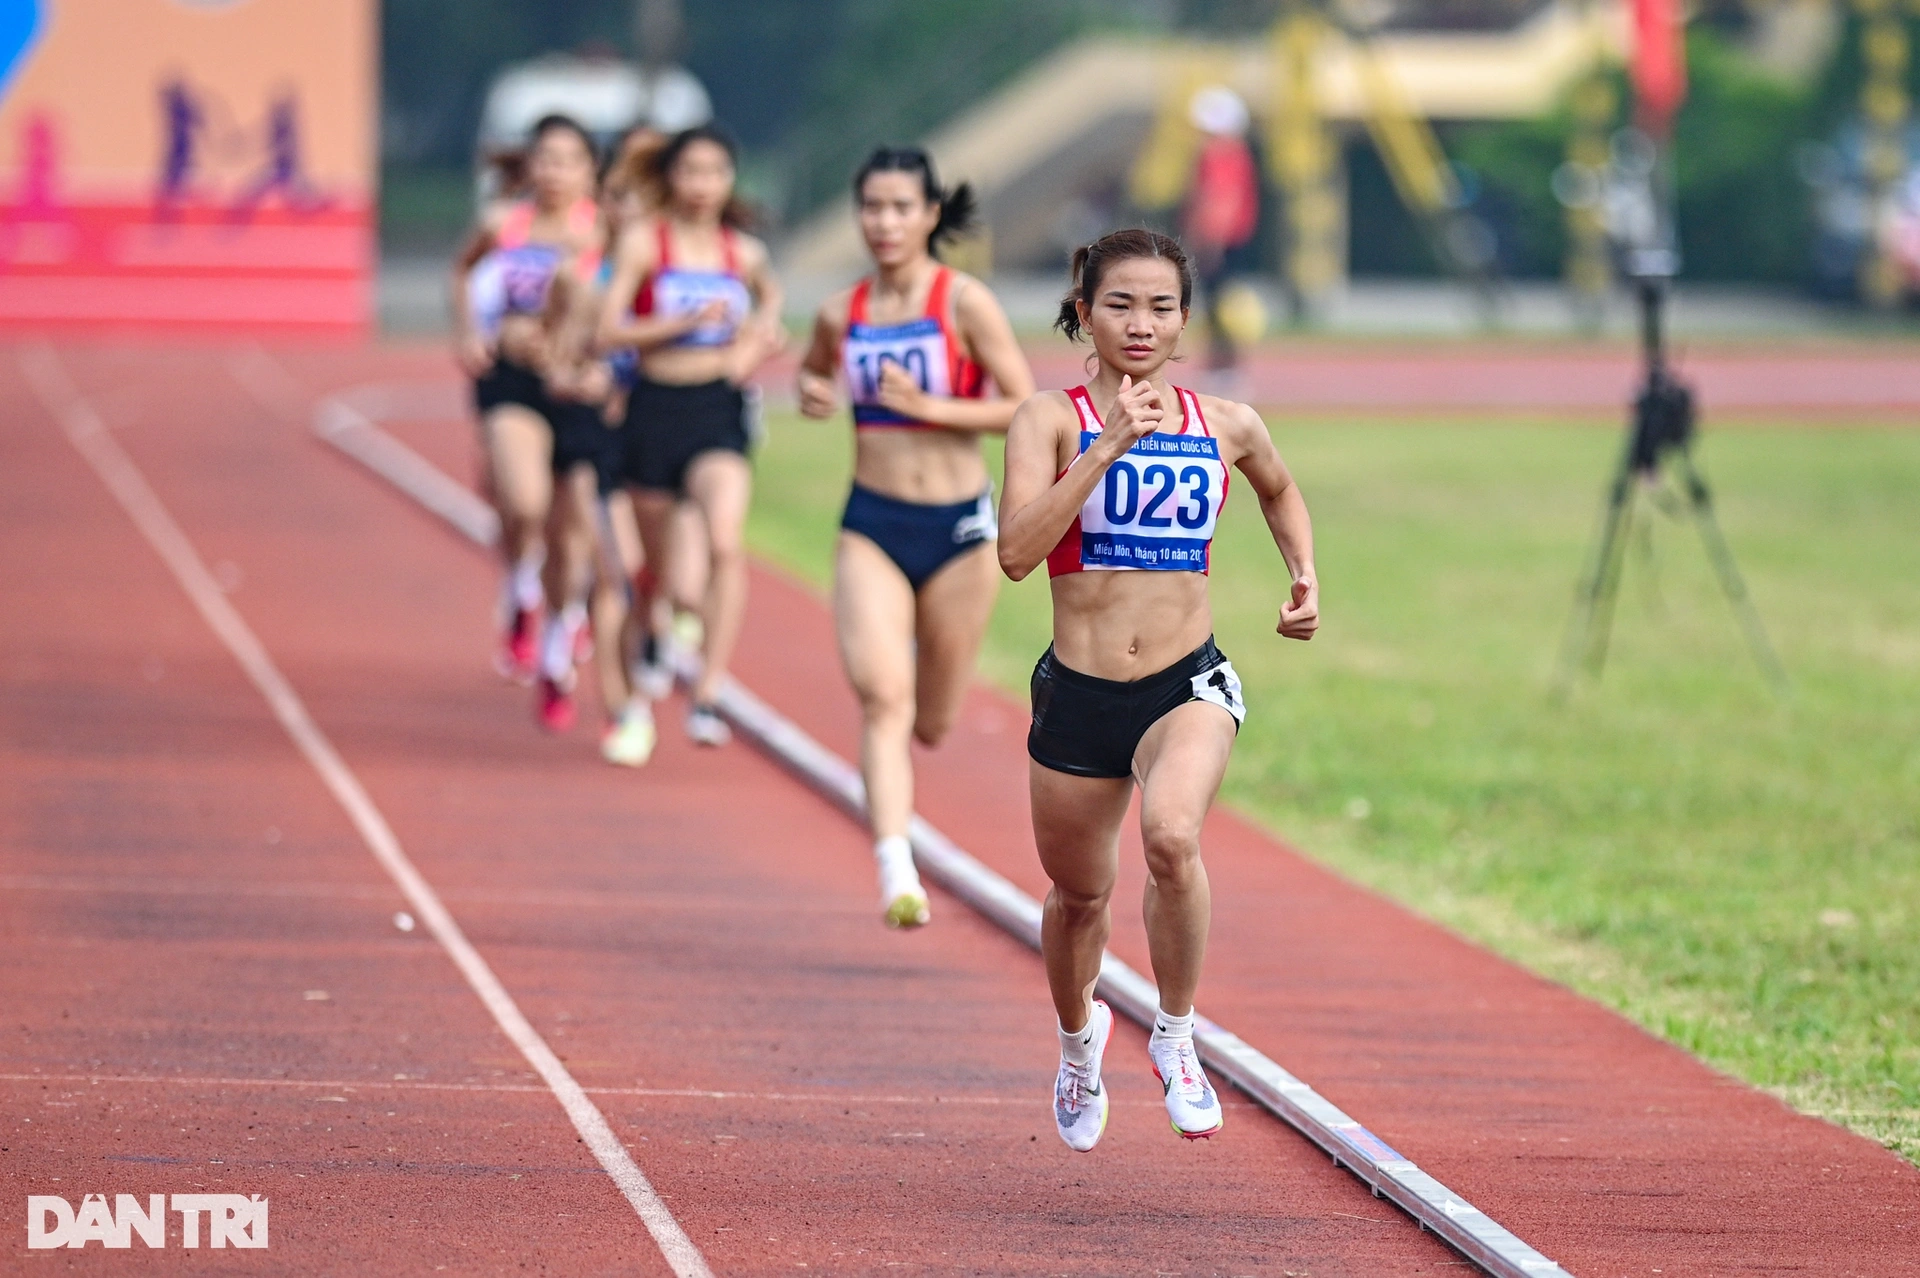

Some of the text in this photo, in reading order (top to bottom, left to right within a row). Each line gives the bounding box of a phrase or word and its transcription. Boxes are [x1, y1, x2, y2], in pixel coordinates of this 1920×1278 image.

[1160, 440, 1179, 452] KINH
[1180, 440, 1200, 453] QUỐC
[1104, 460, 1210, 530] 023
[1135, 546, 1158, 563] tháng
[1160, 548, 1170, 560] 10
[1171, 548, 1188, 560] năm
